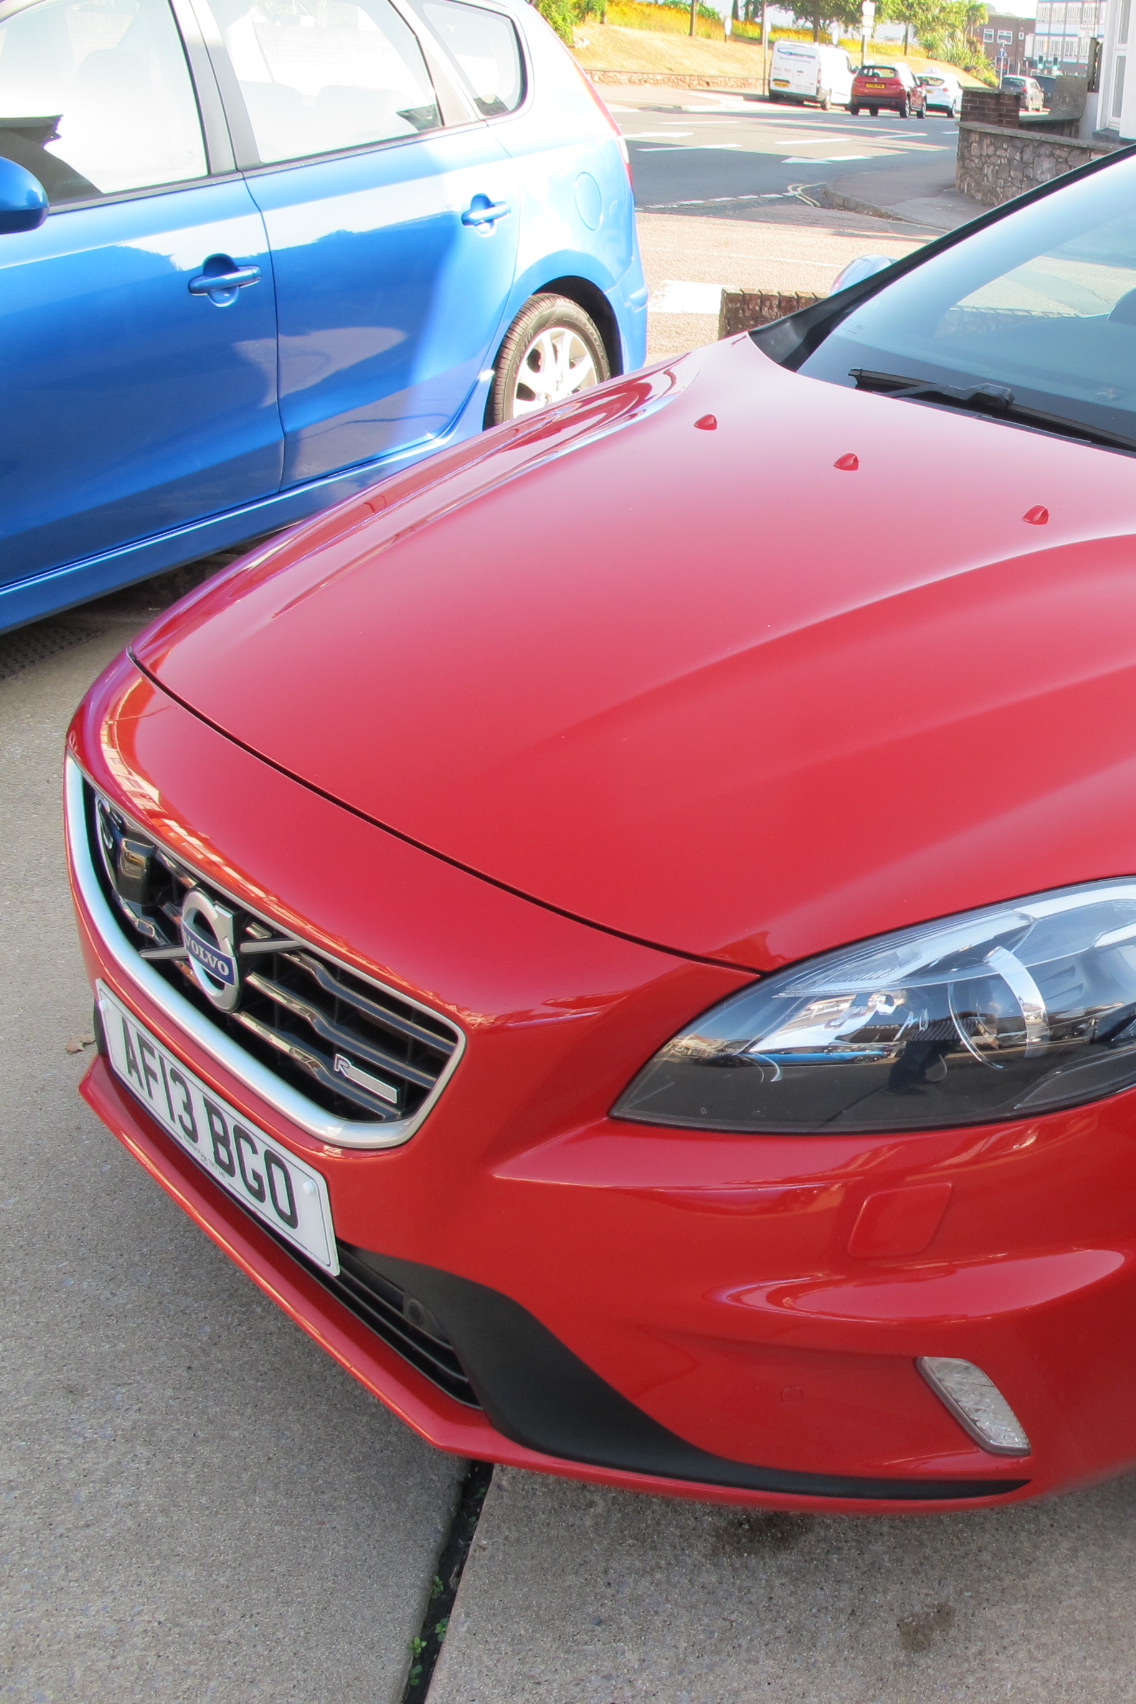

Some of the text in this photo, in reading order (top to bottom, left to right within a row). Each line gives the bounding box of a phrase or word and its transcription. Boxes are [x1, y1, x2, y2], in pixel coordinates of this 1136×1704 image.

[185, 933, 230, 977] VOLVO
[121, 1015, 299, 1230] AF13 BGO
